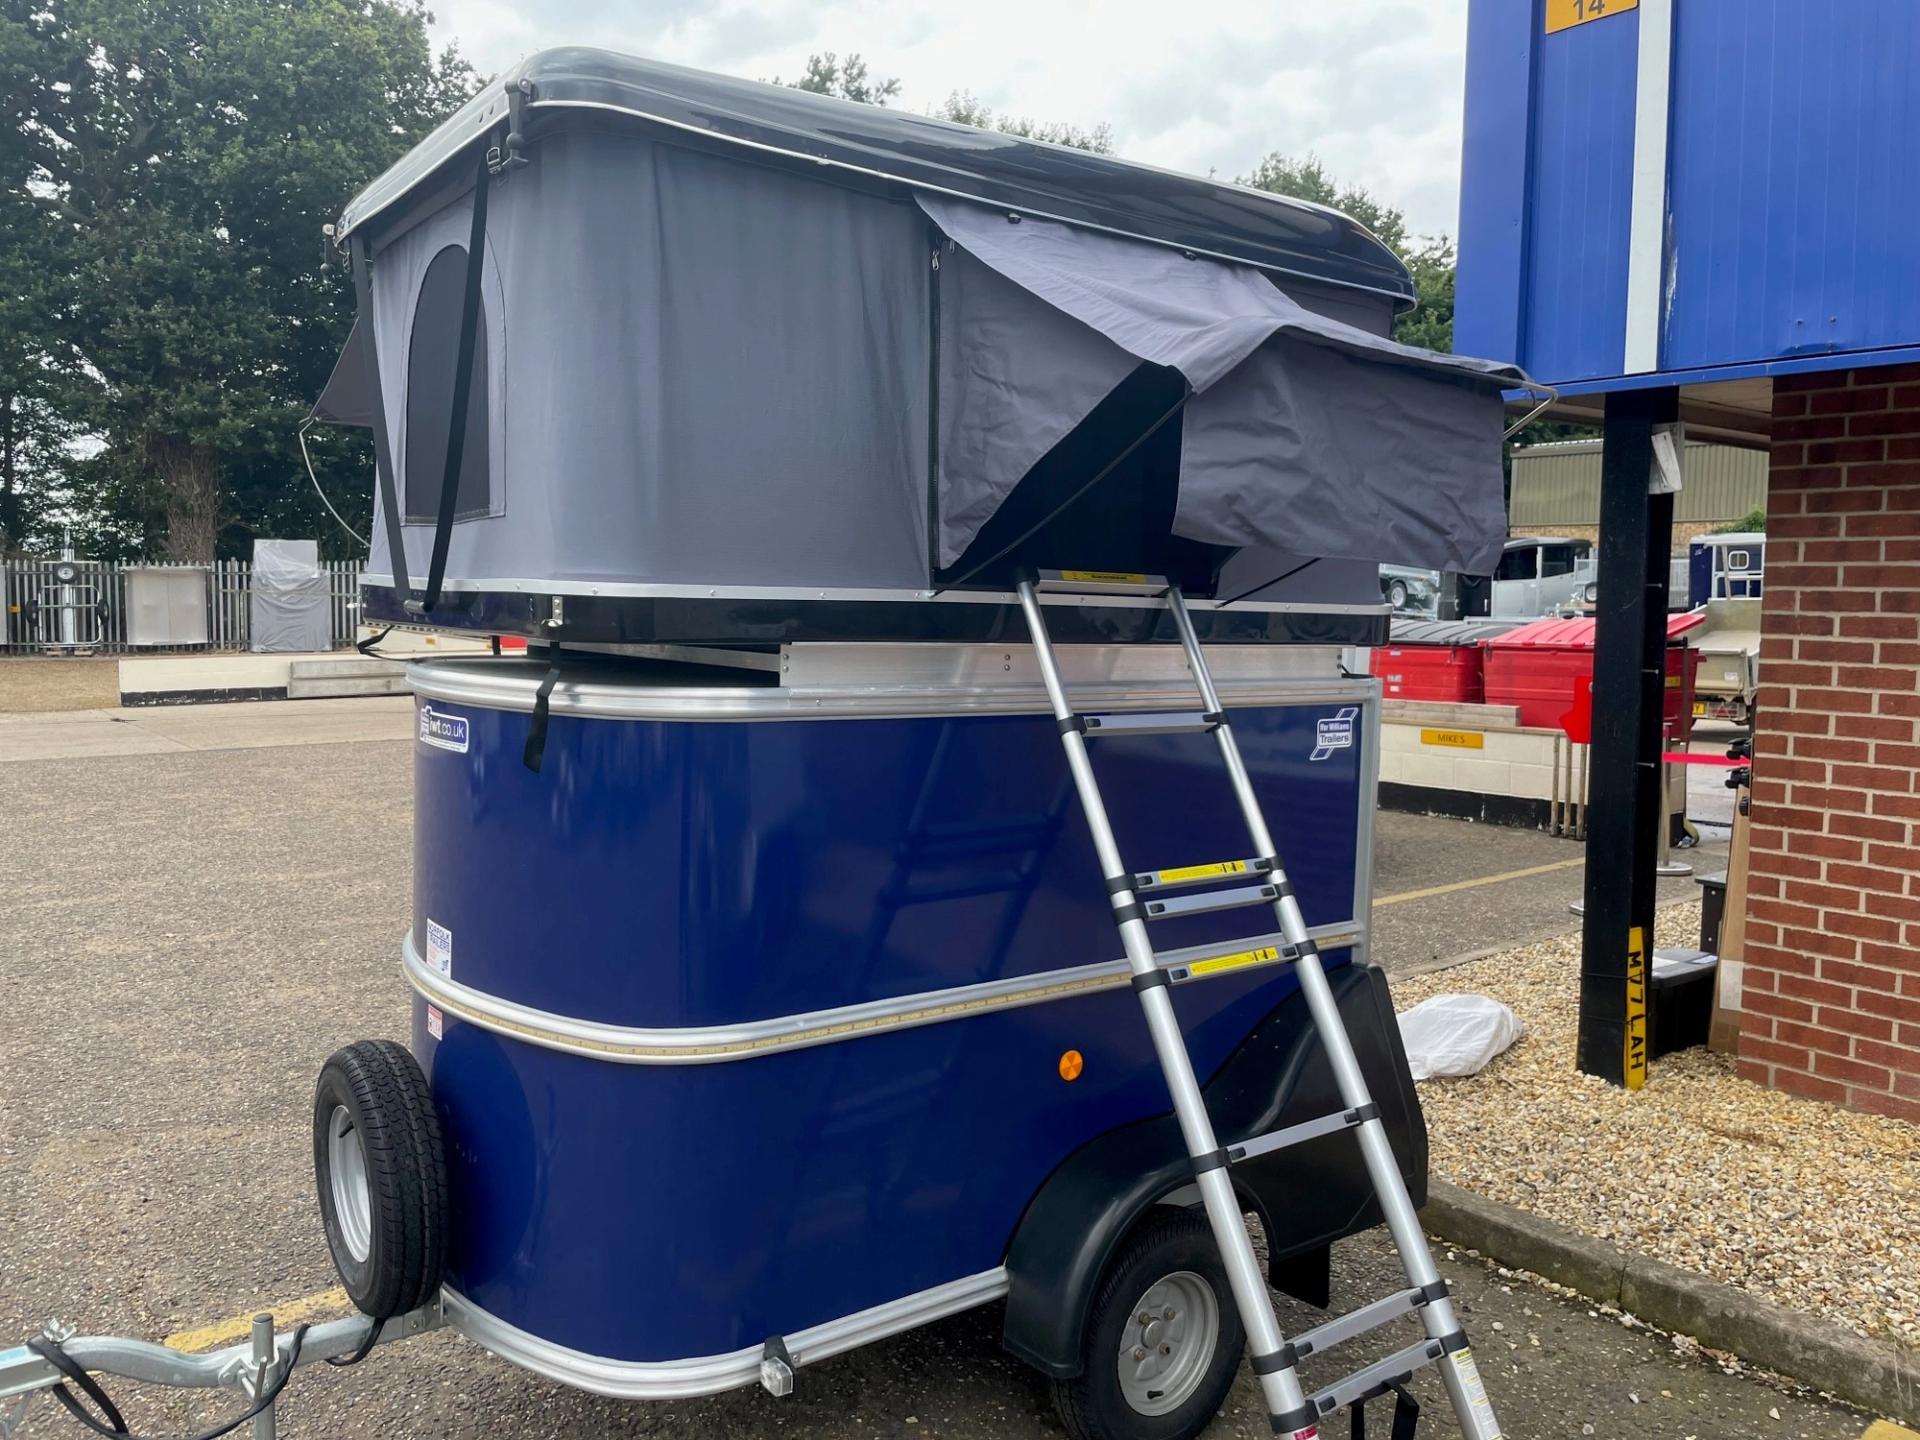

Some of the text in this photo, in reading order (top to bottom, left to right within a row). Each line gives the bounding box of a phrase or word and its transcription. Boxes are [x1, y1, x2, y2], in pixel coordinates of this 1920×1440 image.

[1573, 0, 1605, 20] 14
[429, 716, 465, 739] iwt.co.uk
[1319, 734, 1350, 743] Trailers
[1437, 733, 1465, 744] MIKE'S
